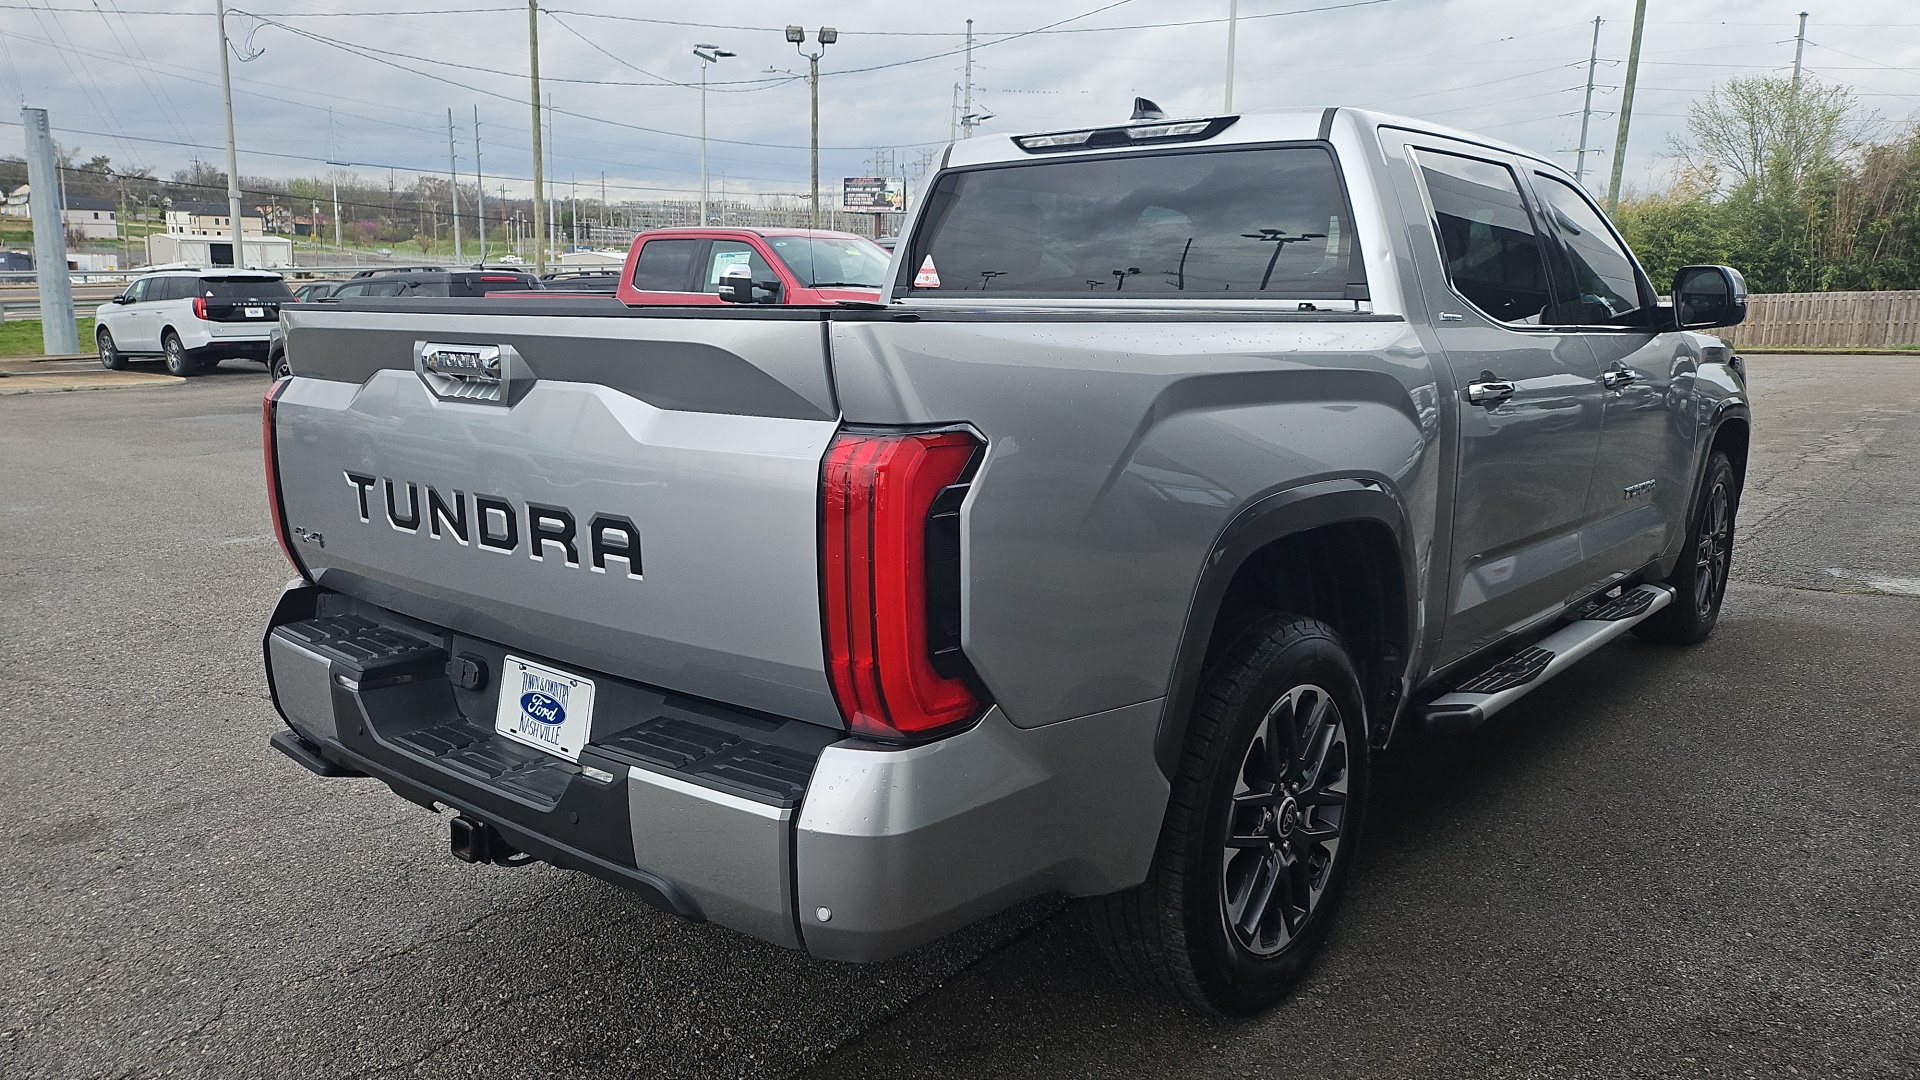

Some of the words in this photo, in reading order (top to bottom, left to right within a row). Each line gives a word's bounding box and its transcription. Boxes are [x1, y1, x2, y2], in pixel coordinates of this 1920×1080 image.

[440, 353, 480, 370] TOYOTA
[343, 469, 644, 581] TUNDRA
[522, 671, 541, 693] TOWN
[540, 677, 545, 692] &
[545, 679, 572, 711] COUNTRY
[527, 694, 558, 721] Ford
[518, 712, 562, 746] NASHVILLE
